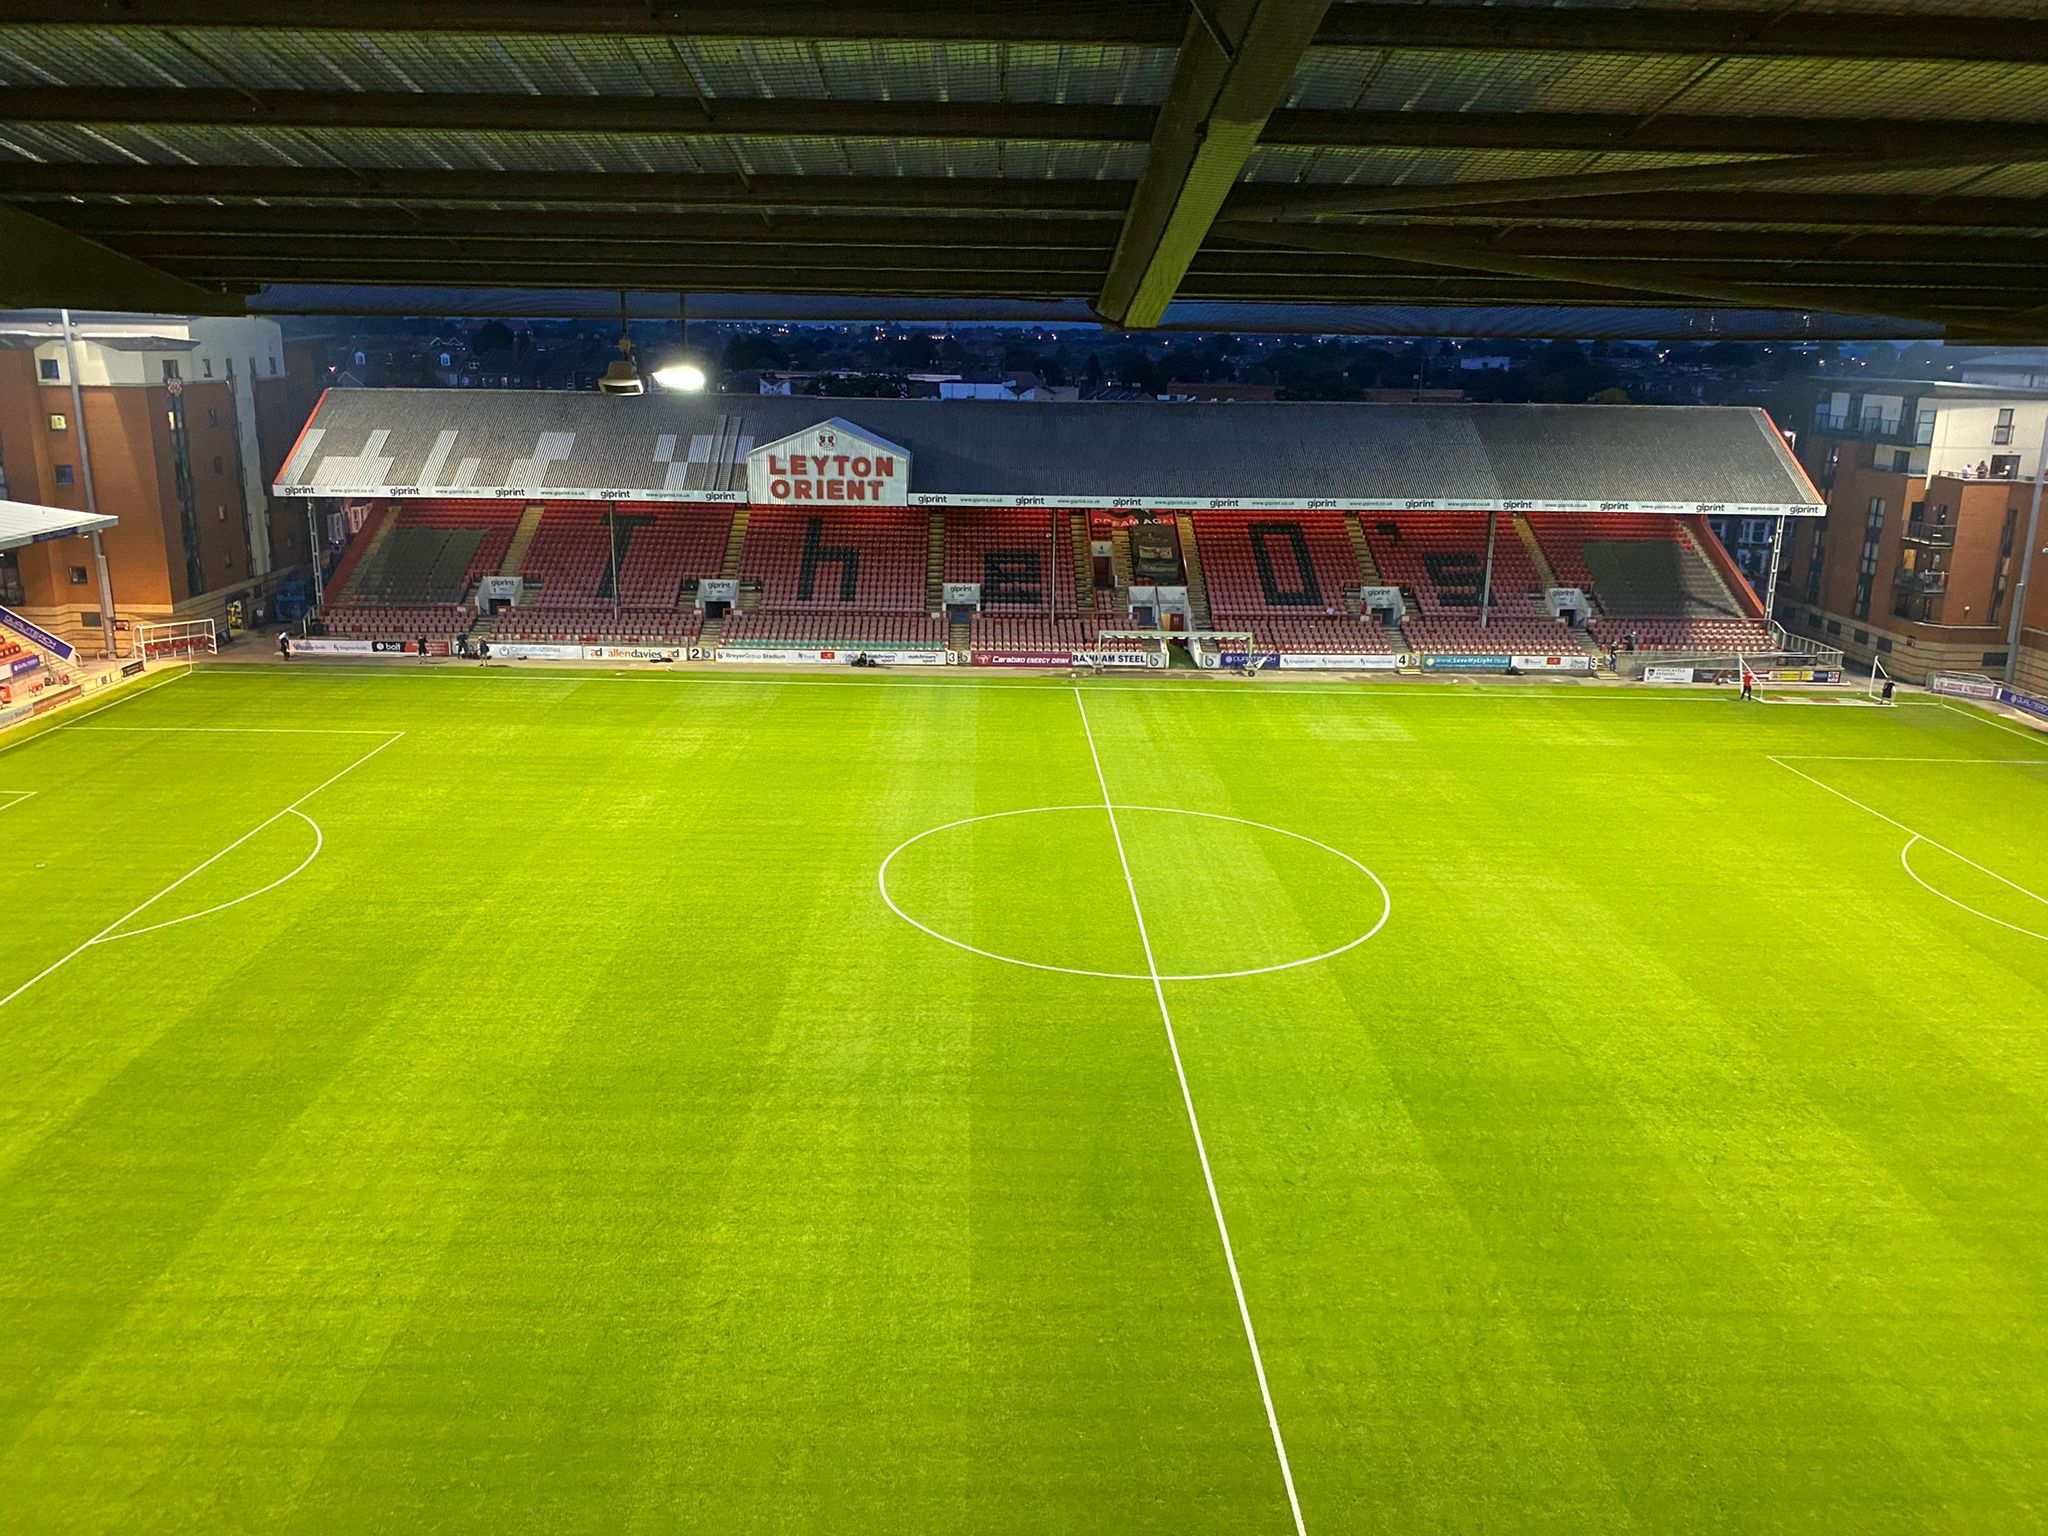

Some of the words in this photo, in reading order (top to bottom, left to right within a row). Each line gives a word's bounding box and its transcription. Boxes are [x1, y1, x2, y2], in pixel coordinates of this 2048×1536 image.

[768, 454, 893, 477] LEYTON
[285, 486, 315, 496] giprint
[390, 486, 420, 496] giprint
[495, 487, 525, 497] giprint
[600, 490, 630, 499] giprint
[771, 479, 883, 500] ORIENT
[706, 491, 735, 501] giprint
[918, 495, 947, 504] giprint
[1015, 496, 1045, 506] giprint
[1113, 497, 1142, 507] giprint
[1210, 498, 1239, 508] giprint
[1308, 498, 1337, 508] giprint
[1405, 500, 1434, 510] giprint
[1503, 500, 1532, 510] giprint
[1600, 501, 1628, 511] giprint
[1696, 503, 1725, 513] giprint
[1790, 505, 1818, 514] giprint
[386, 643, 401, 651] bolt
[608, 649, 662, 659] allendavies
[692, 648, 699, 659] 2
[948, 653, 955, 662] 3
[1118, 654, 1145, 662] STEEL
[992, 655, 1026, 663] Carabao
[1398, 655, 1406, 665] 4
[1591, 658, 1596, 668] 5
